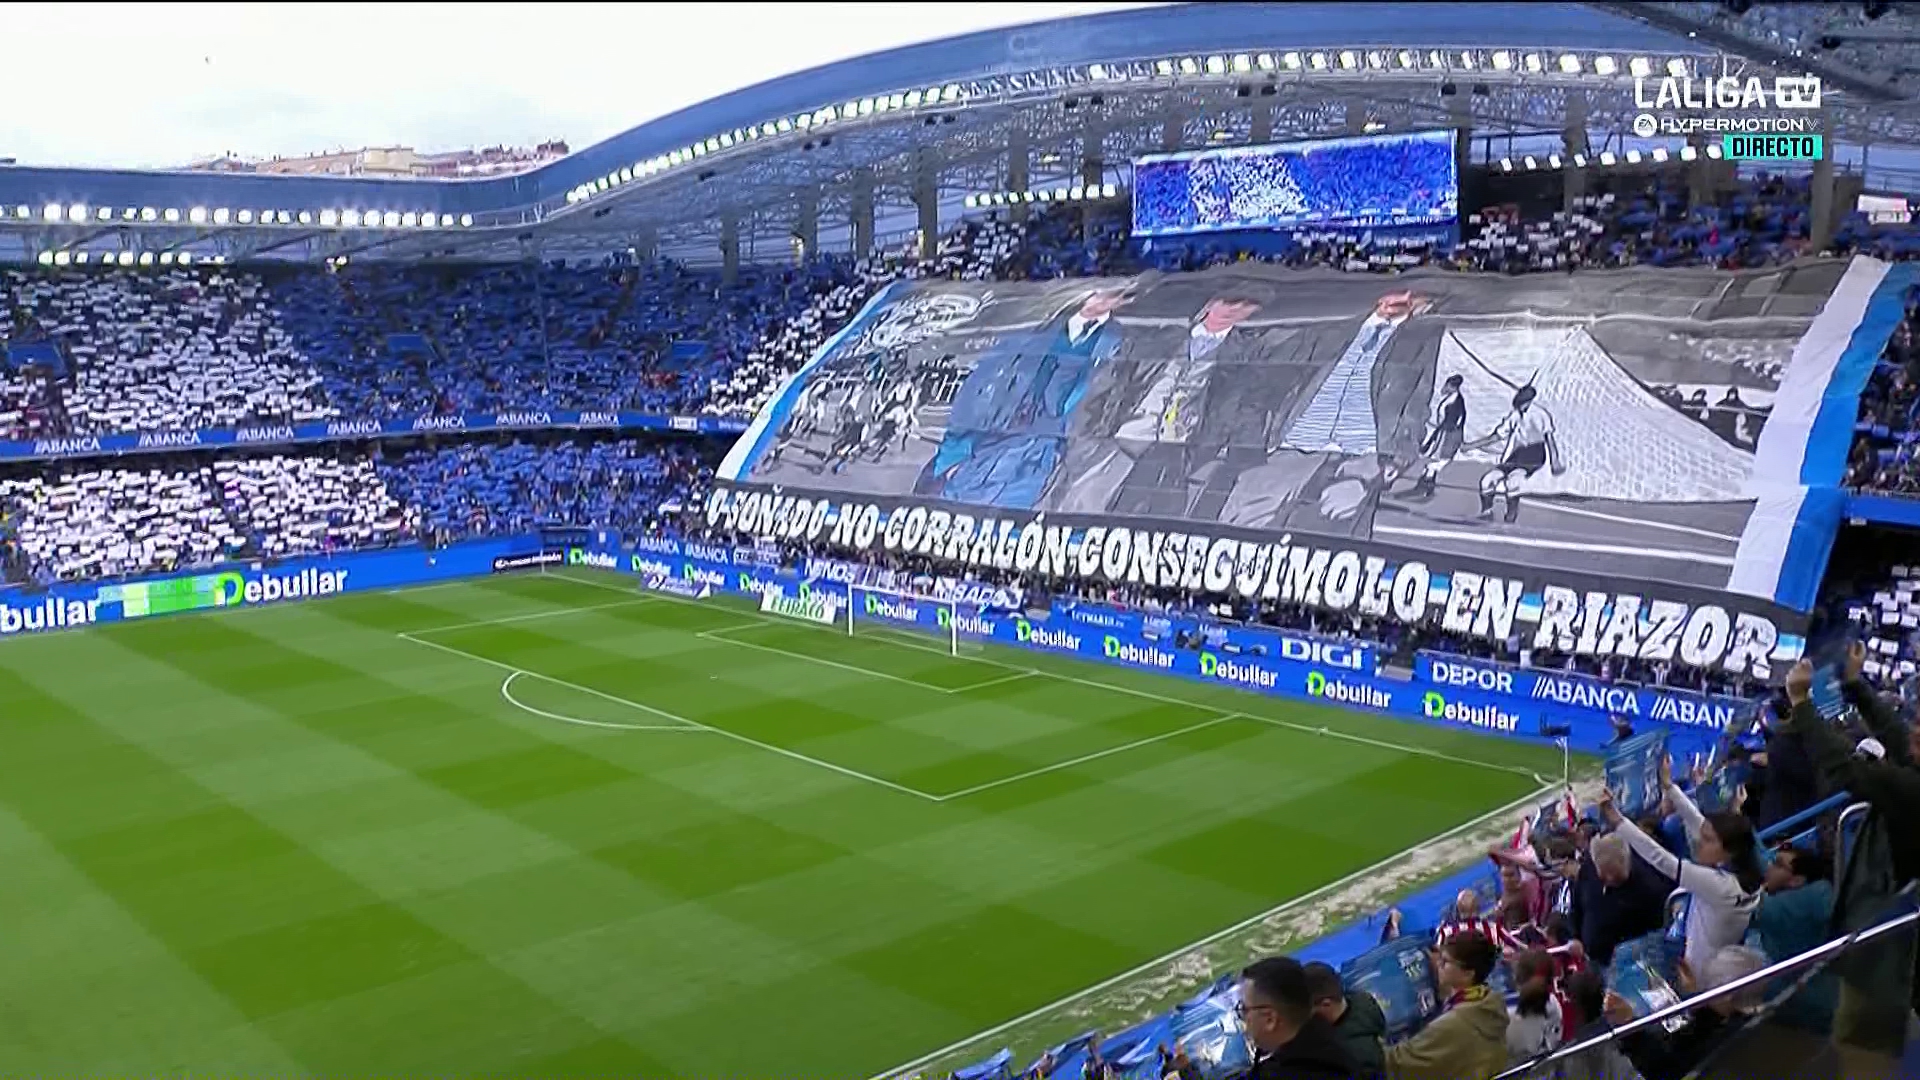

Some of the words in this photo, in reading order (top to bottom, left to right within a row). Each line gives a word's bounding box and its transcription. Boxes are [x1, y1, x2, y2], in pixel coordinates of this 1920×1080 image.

[214, 567, 348, 606] Debullar
[1074, 528, 1431, 620] CONSEGUÍMOLO
[1446, 571, 1519, 640] EN
[1534, 586, 1776, 680] RIAZOR
[865, 594, 918, 622] Debullar
[1015, 620, 1081, 652] Debullar
[1103, 635, 1175, 668] Debullar
[1281, 637, 1363, 669] DIGI
[1200, 652, 1278, 688] Debullar
[1432, 661, 1513, 694] DEPOR
[1307, 670, 1393, 709] Debullar
[1422, 692, 1519, 732] Debullar
[1650, 696, 1736, 731] ABAN
